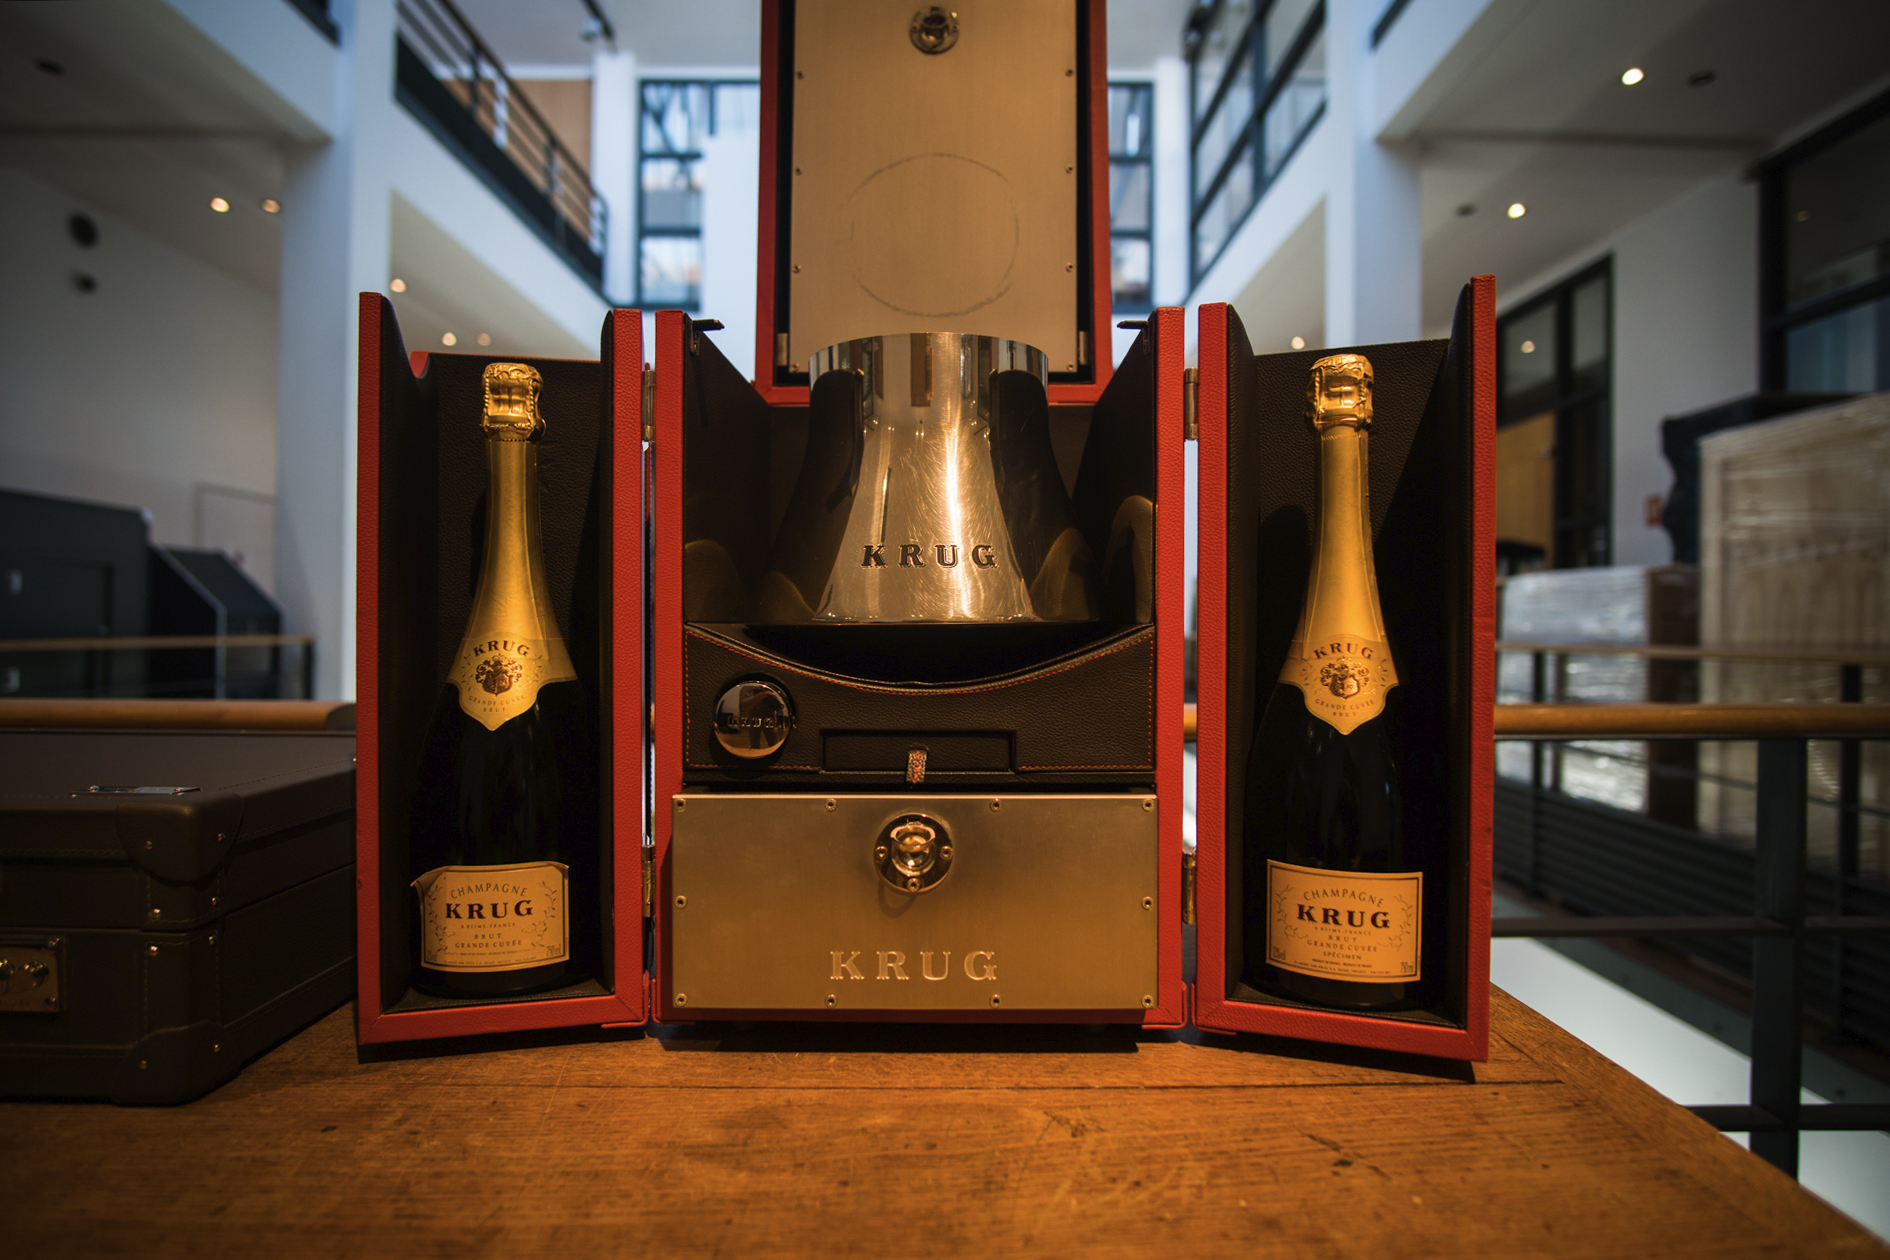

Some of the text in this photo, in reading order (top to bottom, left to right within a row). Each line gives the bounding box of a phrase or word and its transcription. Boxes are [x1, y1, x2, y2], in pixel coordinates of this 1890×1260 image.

[860, 544, 999, 569] KRUG
[473, 640, 530, 657] KRUG
[1313, 642, 1374, 660] KRUG
[469, 695, 497, 706] GRANDE
[1315, 698, 1346, 710] GRANDE
[450, 882, 528, 900] CHAMPAGNE
[1303, 888, 1385, 908] CHAMPAGNE
[445, 899, 534, 920] KRUG
[1296, 903, 1391, 930] KRUG
[474, 932, 502, 940] BRUT
[1306, 939, 1344, 950] GRANDE
[1328, 934, 1358, 943] BRUT
[830, 951, 998, 981] KRUG
